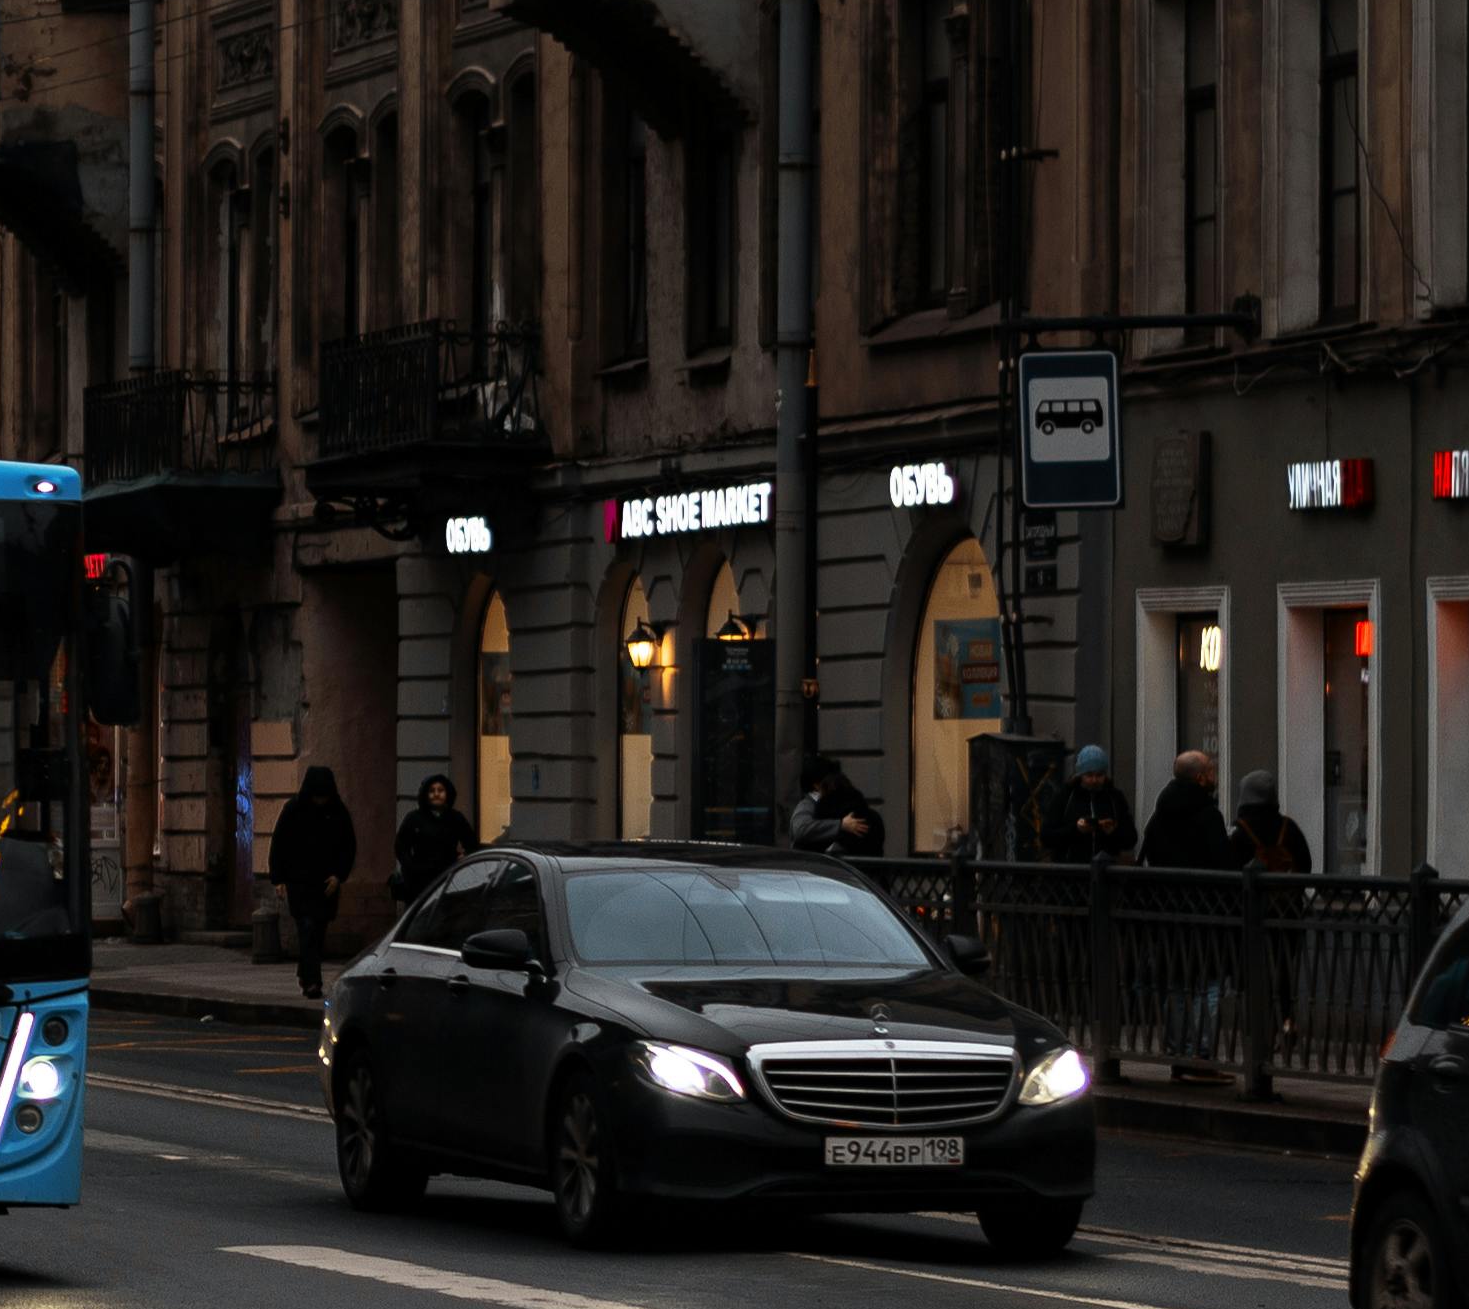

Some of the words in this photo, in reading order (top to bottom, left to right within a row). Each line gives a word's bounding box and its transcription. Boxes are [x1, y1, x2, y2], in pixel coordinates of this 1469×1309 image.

[889, 462, 954, 509] ОБУВЬ
[1287, 459, 1341, 510] УЛИЧНАЯ
[621, 499, 654, 539] ABC
[656, 493, 700, 534] SHOE
[700, 482, 772, 528] MARKET
[445, 516, 492, 553] ОБУВЬ
[832, 1140, 921, 1164] Е944ВР
[925, 1139, 960, 1157] 198
